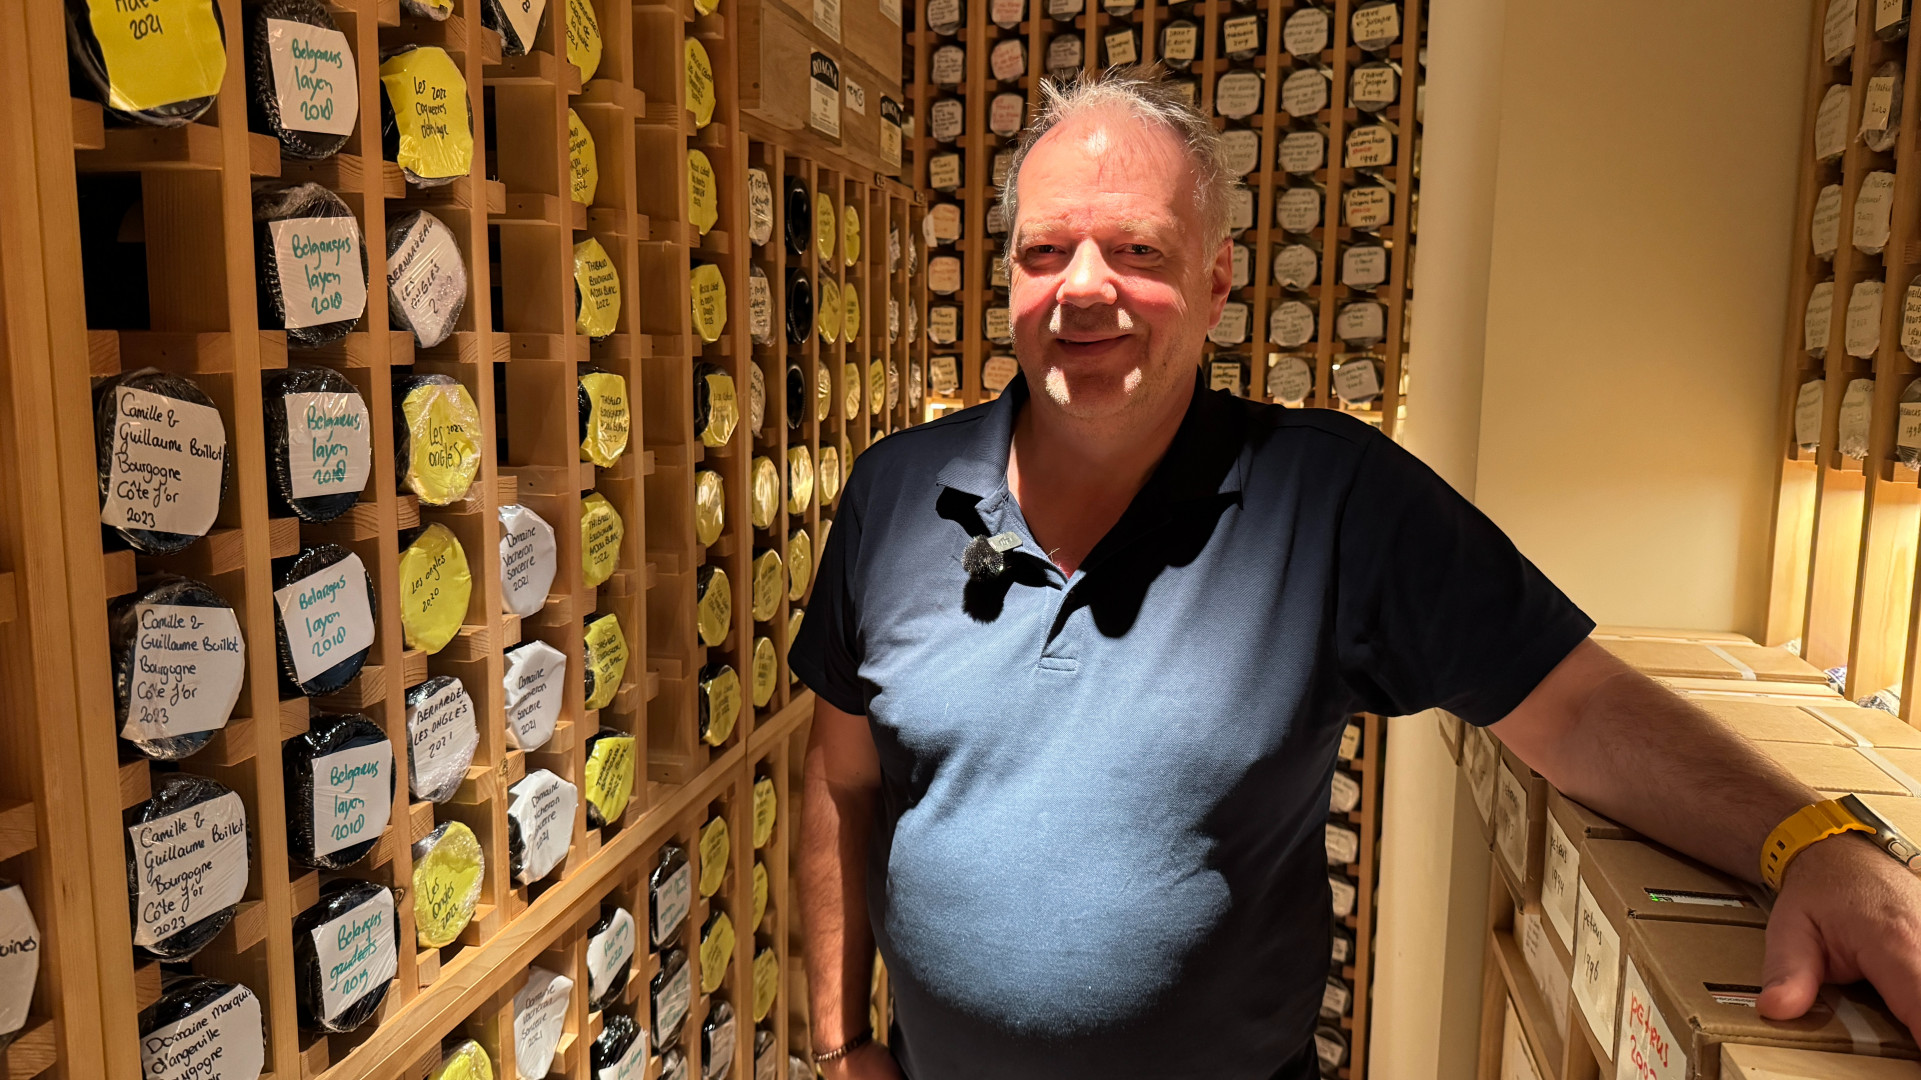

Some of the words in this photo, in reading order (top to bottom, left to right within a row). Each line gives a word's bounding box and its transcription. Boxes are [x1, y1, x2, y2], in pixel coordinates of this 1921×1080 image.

[130, 14, 163, 39] 2021
[413, 76, 426, 95] Les
[312, 292, 342, 315] 2018
[120, 391, 163, 419] Camille
[119, 422, 183, 453] Guillaume
[429, 418, 443, 447] Les
[114, 441, 182, 485] Bourgogne
[117, 480, 149, 500] Côte
[127, 507, 156, 528] 2023
[412, 577, 423, 594] Les
[513, 575, 529, 592] 2021
[422, 587, 439, 613] 2020
[141, 609, 196, 630] Camille
[141, 633, 199, 651] Guillaume
[312, 626, 346, 658] 2018
[140, 655, 196, 684] Bourgogne
[414, 729, 429, 746] LES
[521, 719, 536, 736] 2021
[429, 731, 452, 758] 2021
[140, 818, 187, 848] Camille
[331, 814, 365, 841] 2018
[144, 840, 205, 883] Guillaume
[150, 861, 212, 895] Bourgogne
[425, 877, 439, 904] Les
[144, 899, 184, 924] Côte
[154, 916, 186, 937] 2023
[1583, 909, 1601, 946] petrus
[1584, 946, 1599, 983] 1996
[146, 1018, 208, 1054] Domaine
